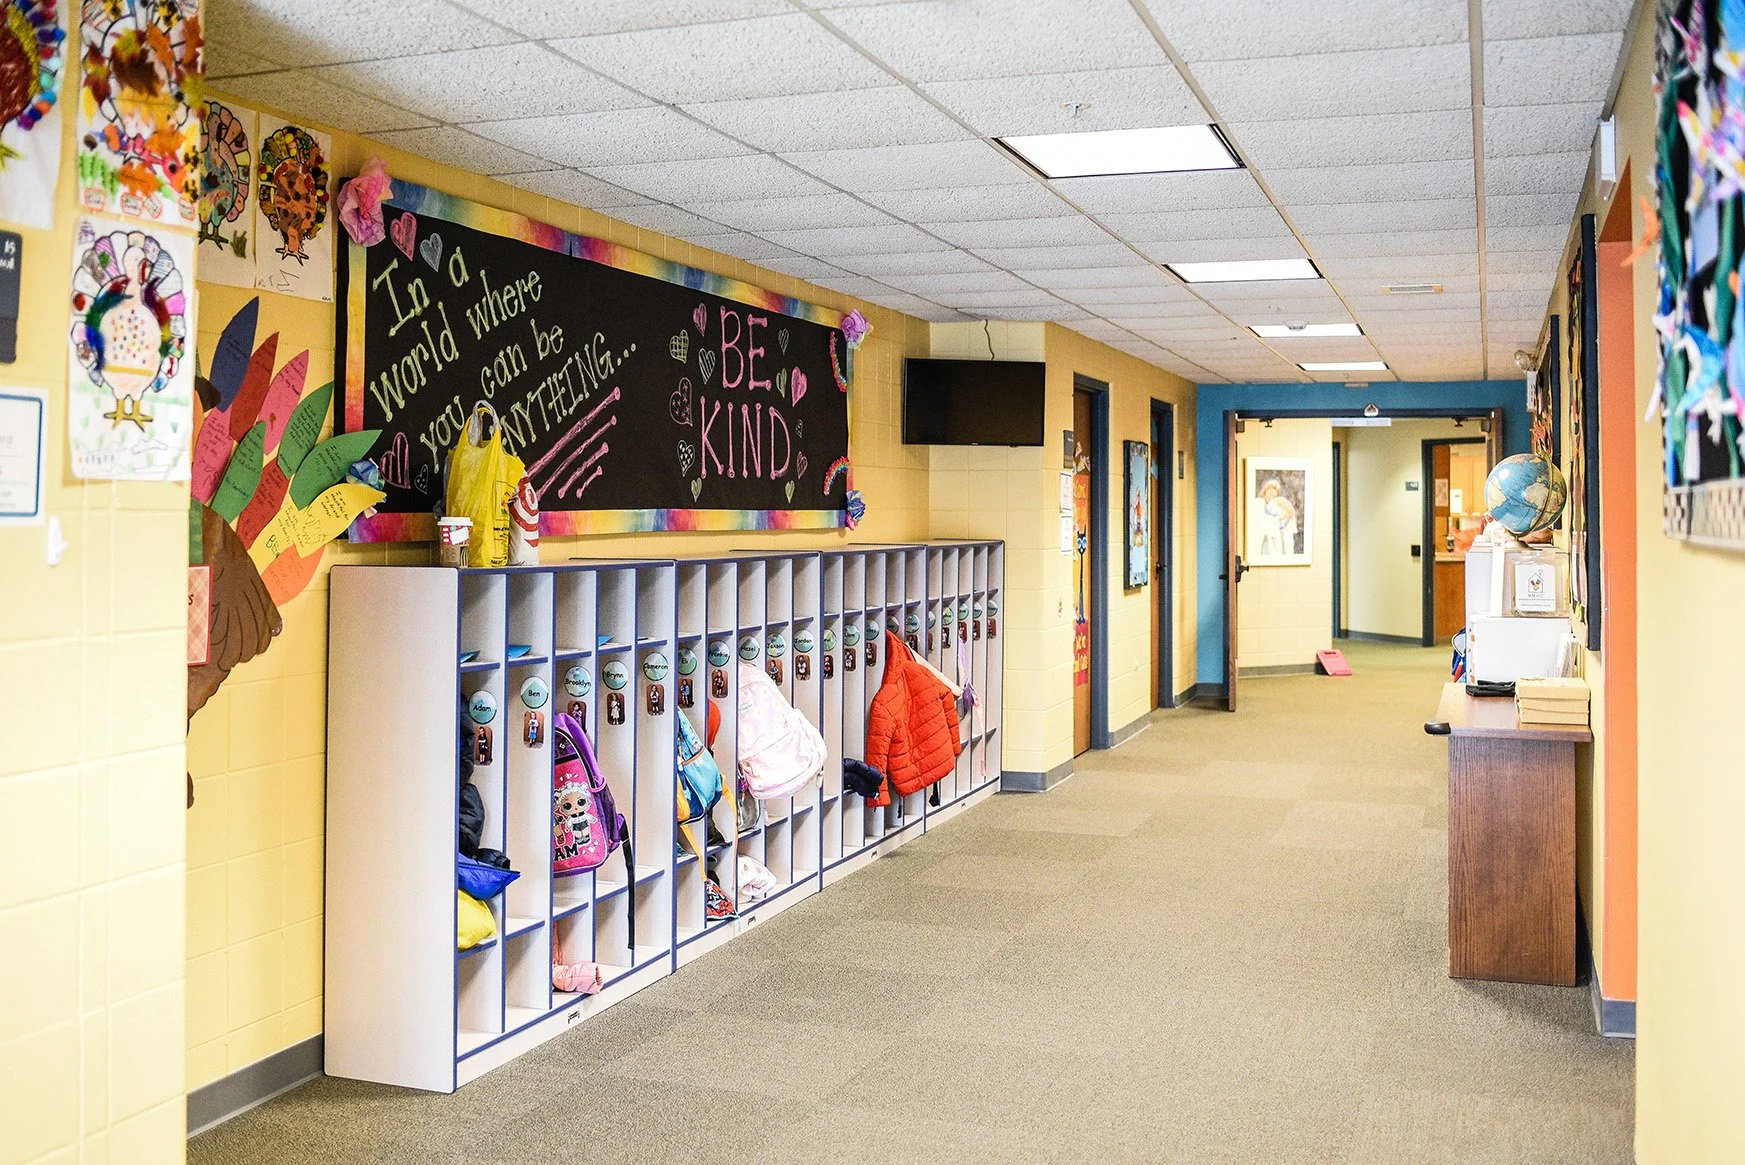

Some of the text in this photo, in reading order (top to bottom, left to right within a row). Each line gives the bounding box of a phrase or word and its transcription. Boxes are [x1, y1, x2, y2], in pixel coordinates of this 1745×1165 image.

[372, 257, 430, 337] In
[448, 246, 470, 288] a
[369, 300, 460, 424] world
[466, 269, 542, 340] where
[720, 305, 772, 391] BE
[419, 317, 564, 474] you can be
[488, 331, 637, 457] NYTHING...
[700, 395, 791, 480] KIND
[472, 703, 492, 712] Adam
[565, 678, 592, 688] Brooklyn
[606, 672, 624, 680] Brynn
[644, 662, 669, 670] Cameron
[555, 843, 579, 861] AM
